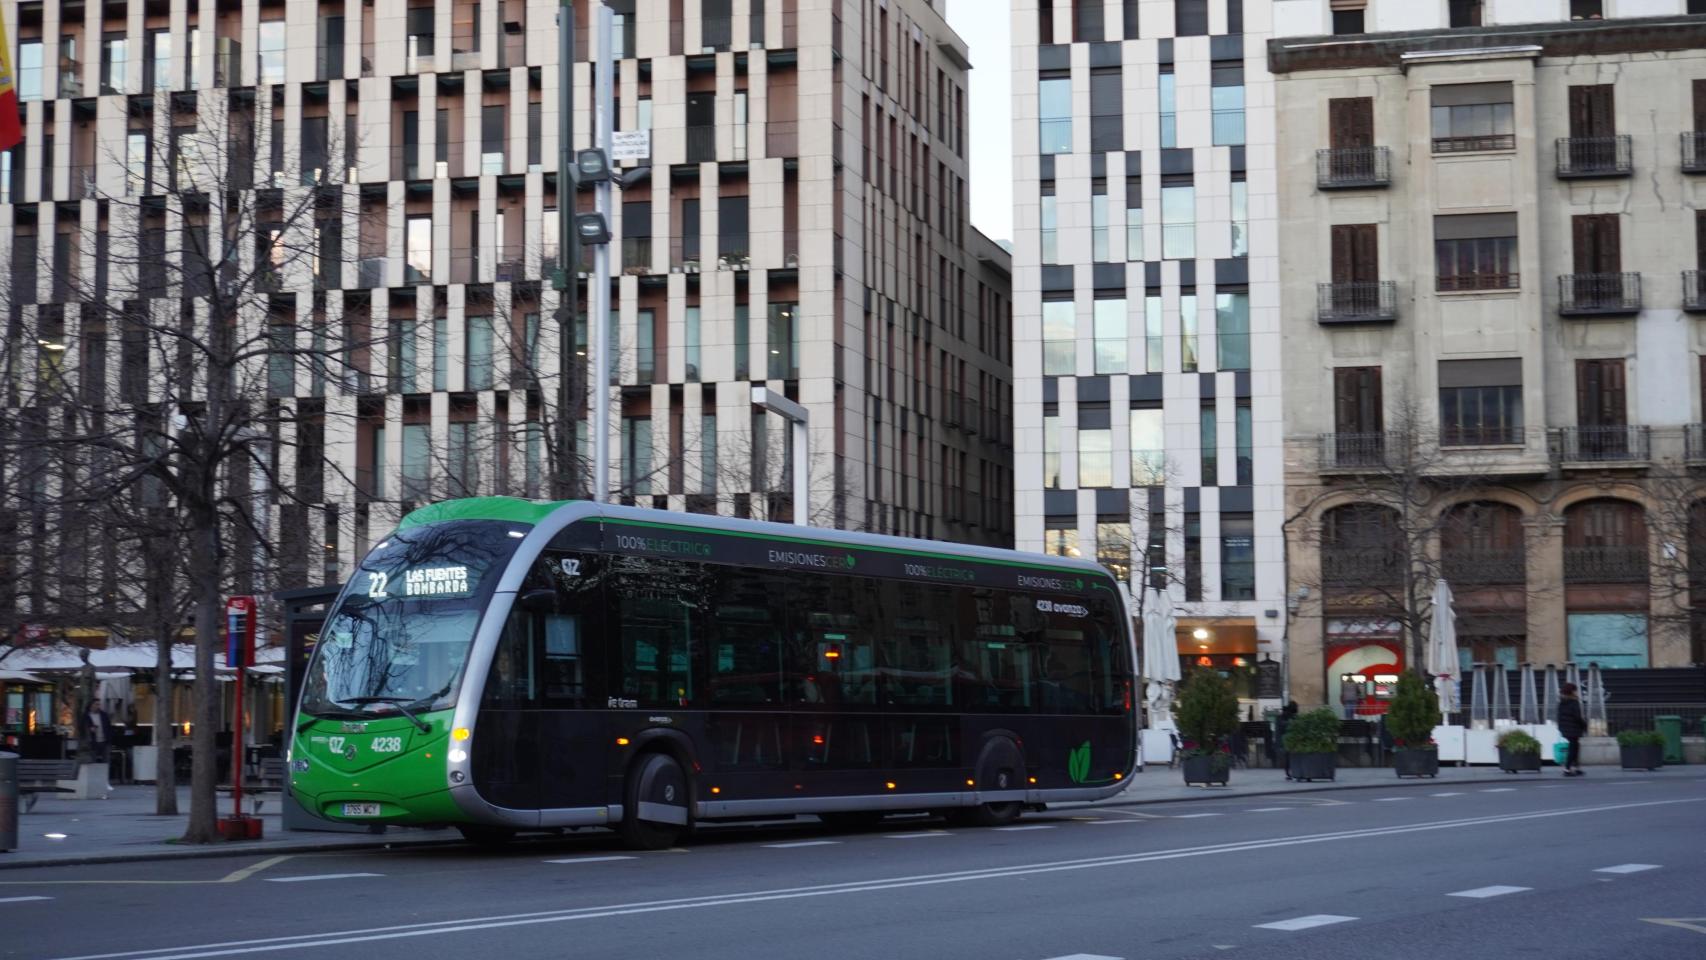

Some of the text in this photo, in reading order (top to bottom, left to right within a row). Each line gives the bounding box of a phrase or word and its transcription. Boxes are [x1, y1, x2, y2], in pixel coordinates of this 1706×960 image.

[406, 566, 468, 583] LAS FUENTES
[368, 571, 388, 598] 22
[406, 580, 468, 596] BOMBARDA
[371, 736, 402, 753] 4238
